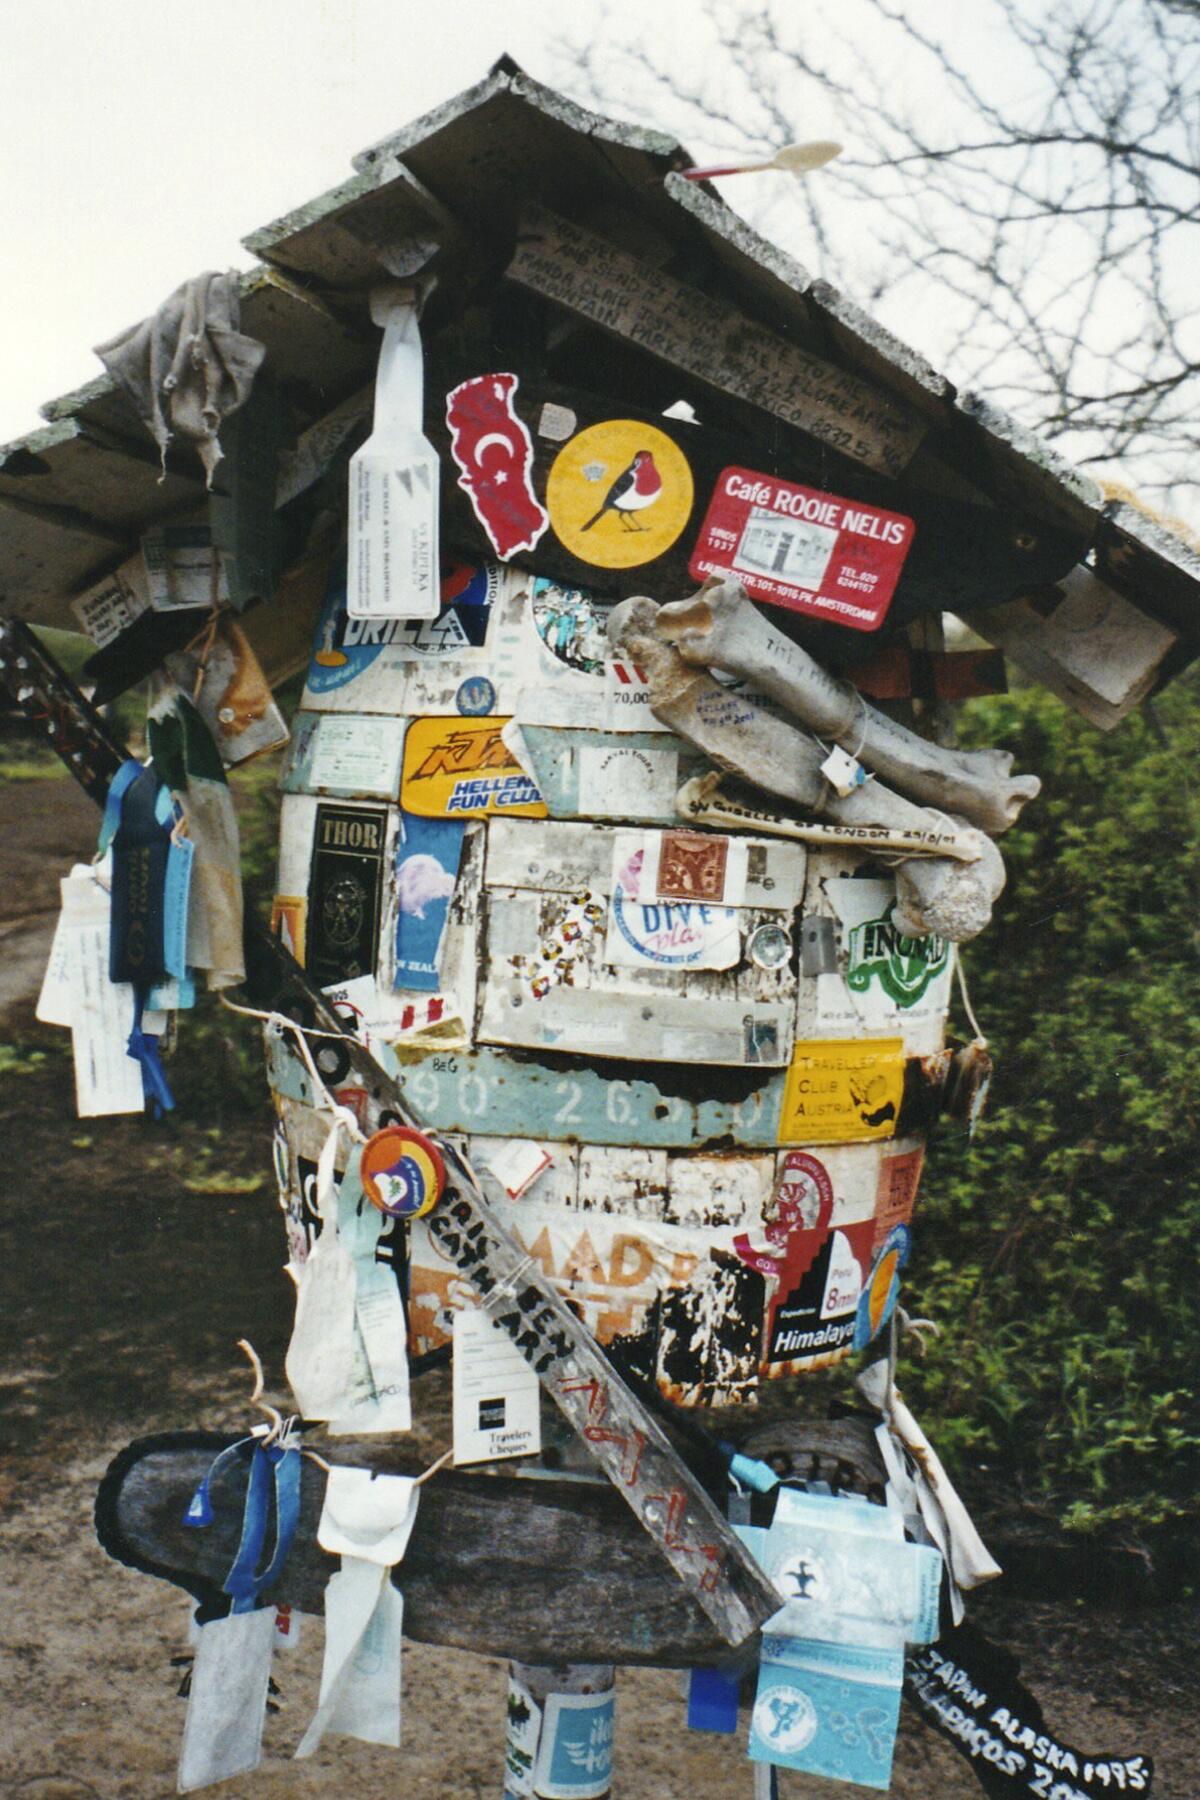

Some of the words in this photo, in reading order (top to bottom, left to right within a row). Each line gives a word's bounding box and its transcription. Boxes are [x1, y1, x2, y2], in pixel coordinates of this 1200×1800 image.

[723, 473, 773, 507] Café
[772, 488, 841, 526] ROOIE
[840, 509, 906, 545] NELIS
[706, 537, 734, 552] 1937
[813, 595, 878, 622] AMSTERDAM
[447, 793, 490, 812] FUN
[713, 800, 783, 824] GISELLE
[821, 823, 891, 840] LONDON
[323, 819, 378, 849] THOR
[642, 903, 713, 934] DIVE
[797, 1078, 839, 1095] CLUB
[794, 1103, 854, 1117] AUSTRIA
[489, 1430, 532, 1443] Travelers
[489, 1443, 528, 1455] Cheques
[920, 1649, 986, 1710] JAPAN
[989, 1707, 1079, 1777] ALASKA
